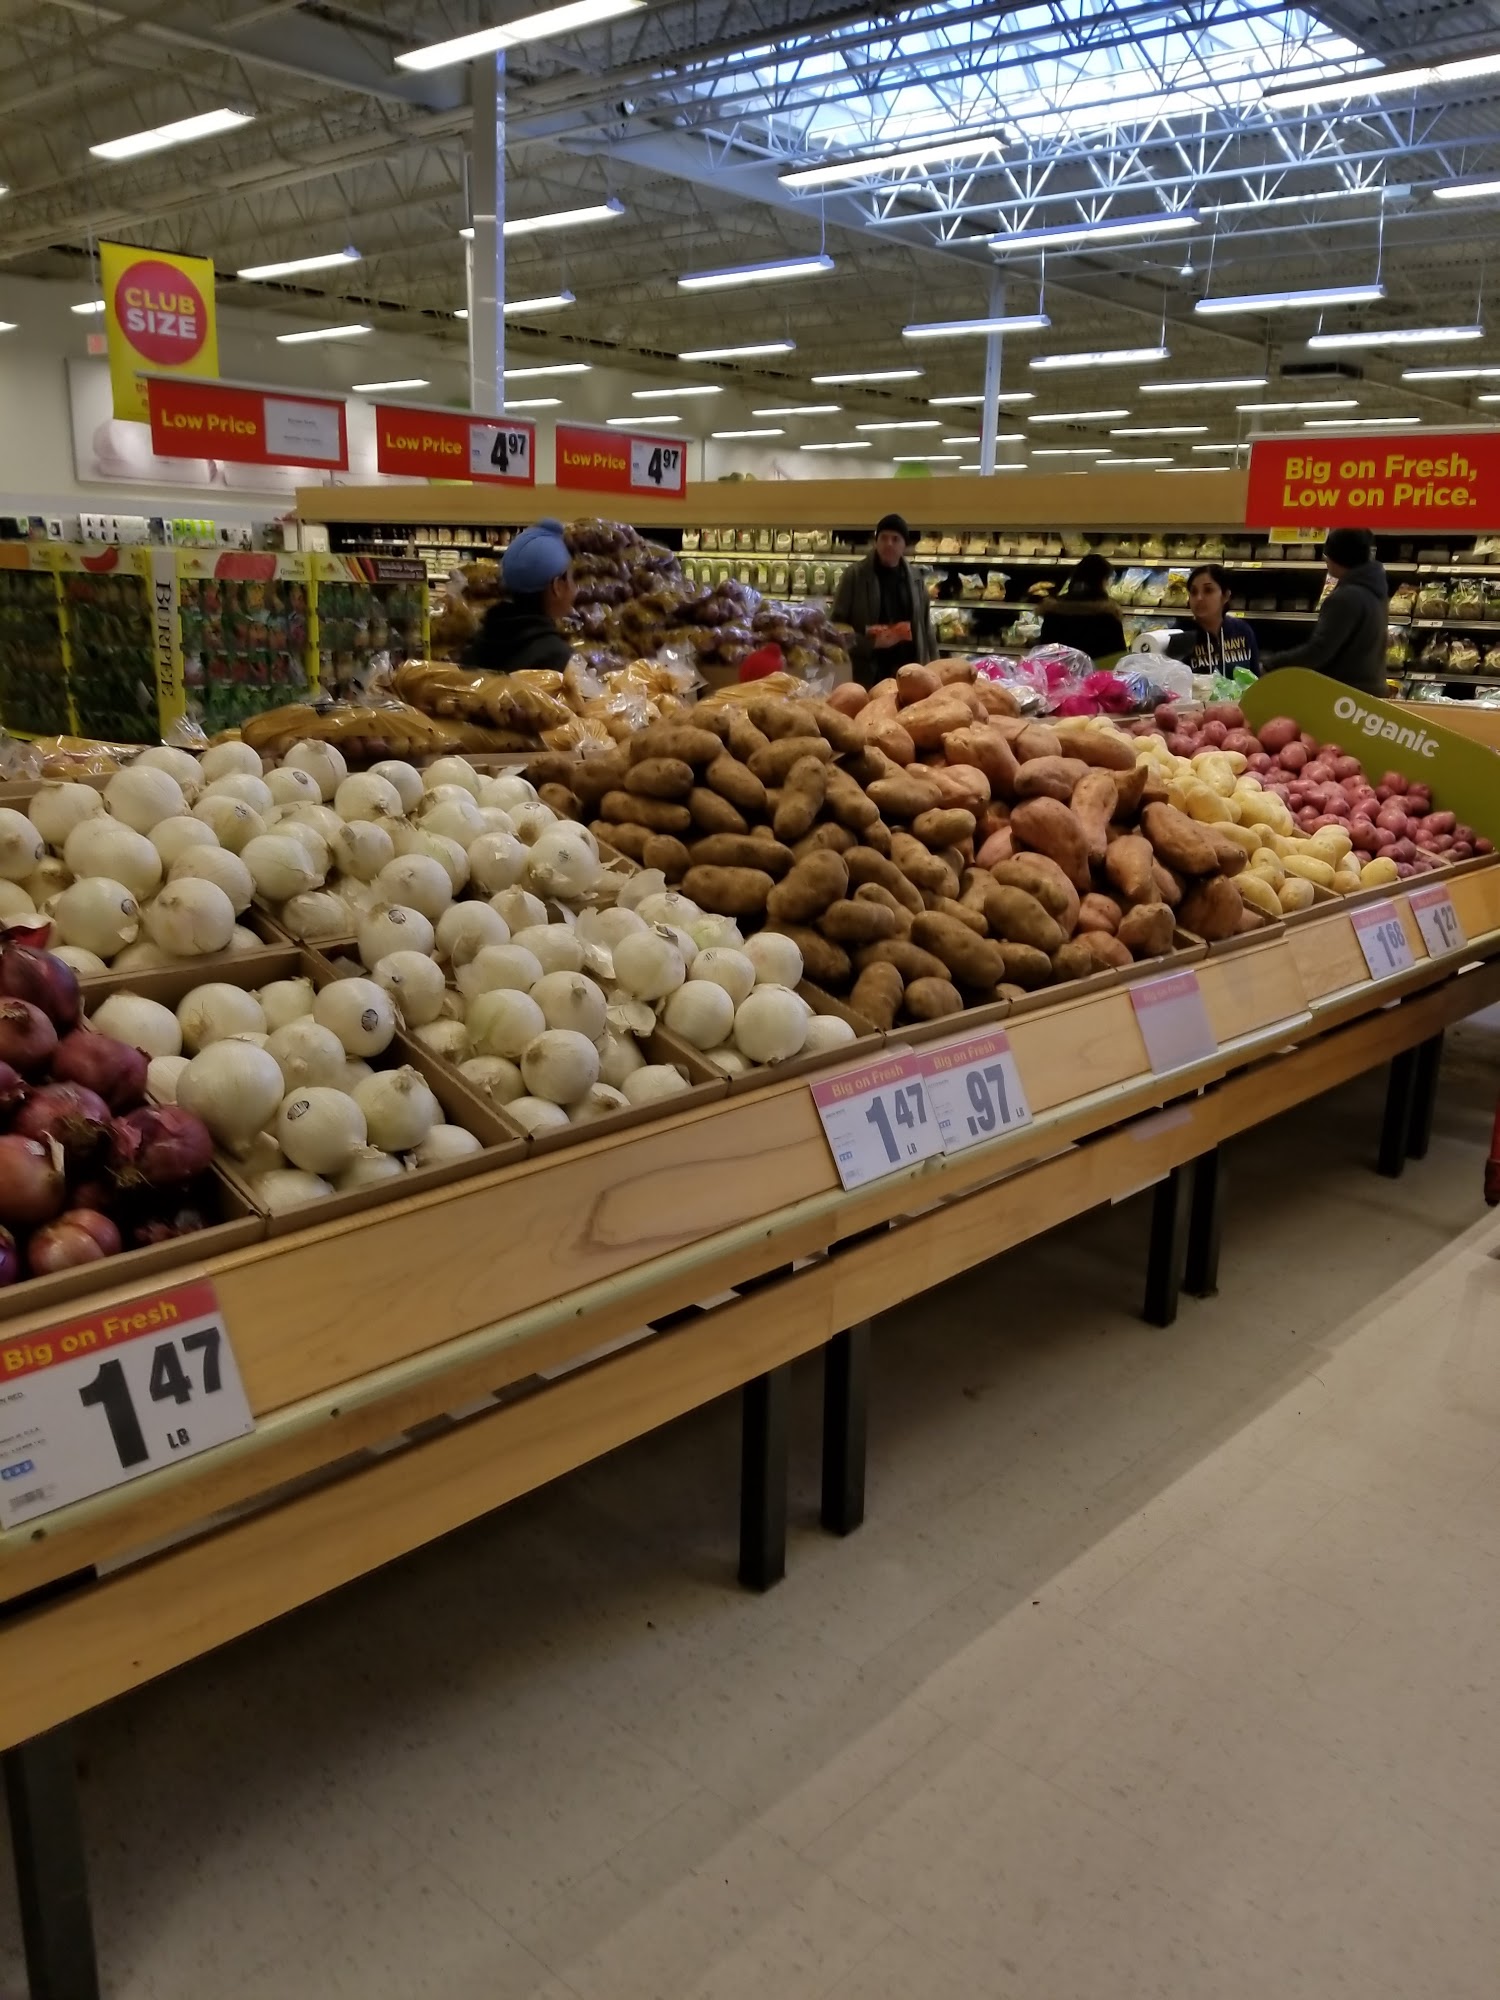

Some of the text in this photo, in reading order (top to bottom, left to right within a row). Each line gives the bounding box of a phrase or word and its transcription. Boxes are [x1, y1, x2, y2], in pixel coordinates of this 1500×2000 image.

[124, 287, 196, 316] CLUB
[126, 307, 197, 339] SIZE
[161, 408, 257, 435] Low Price
[386, 432, 462, 455] Low Price
[563, 449, 626, 470] Low Price
[1285, 452, 1477, 484] Big on Fresh,
[1283, 482, 1477, 507] Low on Price.
[156, 579, 173, 696] BURPEE
[1195, 636, 1246, 656] OLD NAVY
[1334, 696, 1439, 757] Organic
[933, 1042, 996, 1070] Big on Fresh
[831, 1065, 904, 1098] Big on Fresh
[906, 1142, 918, 1155] LB
[3, 1301, 178, 1371] Big on Fresh
[167, 1428, 190, 1449] LB
